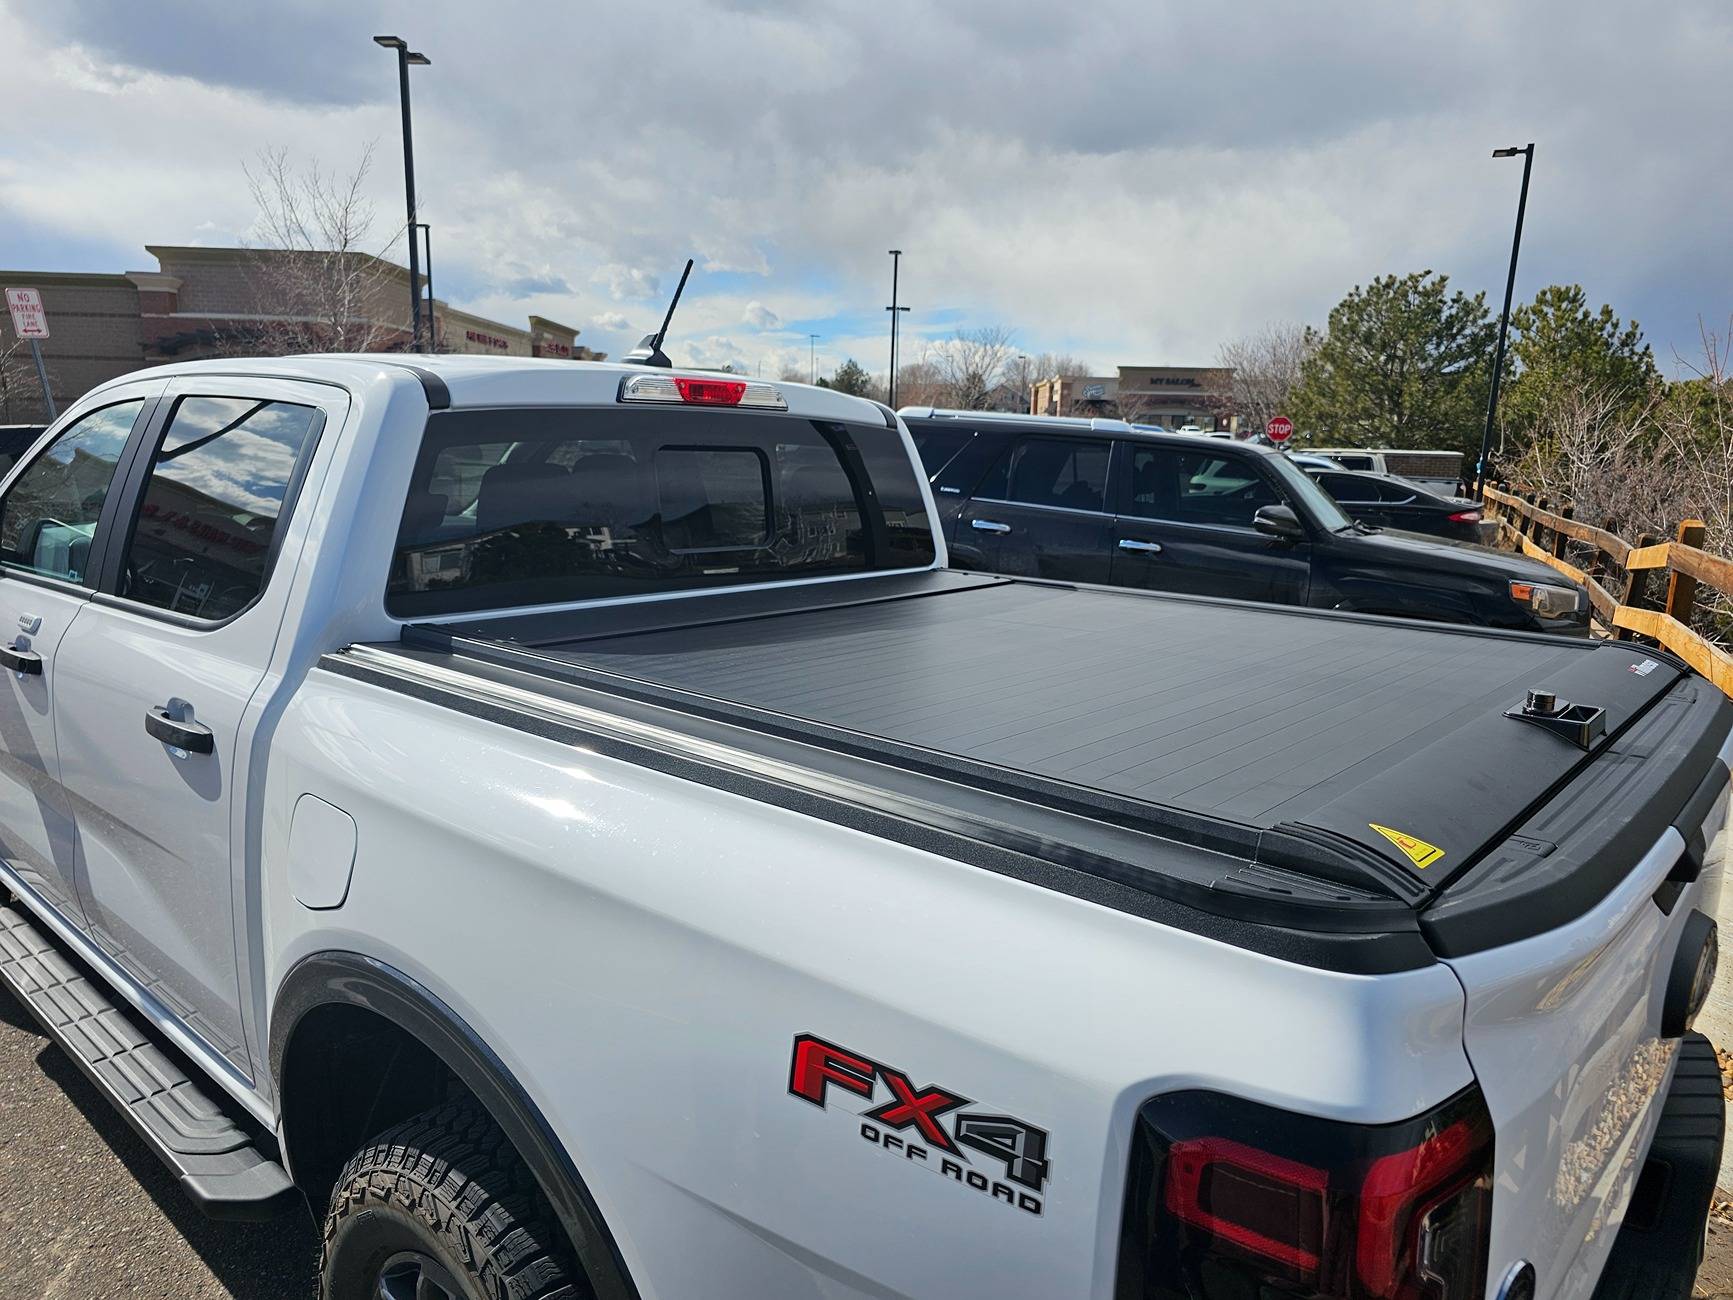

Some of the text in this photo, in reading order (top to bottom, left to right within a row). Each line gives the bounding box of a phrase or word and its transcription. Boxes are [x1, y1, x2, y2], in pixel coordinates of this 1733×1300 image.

[16, 292, 30, 303] NO
[11, 303, 41, 313] PARKING
[1267, 423, 1291, 435] STOP
[787, 1032, 1052, 1194] FX4
[859, 1123, 1043, 1216] OFF ROAD
